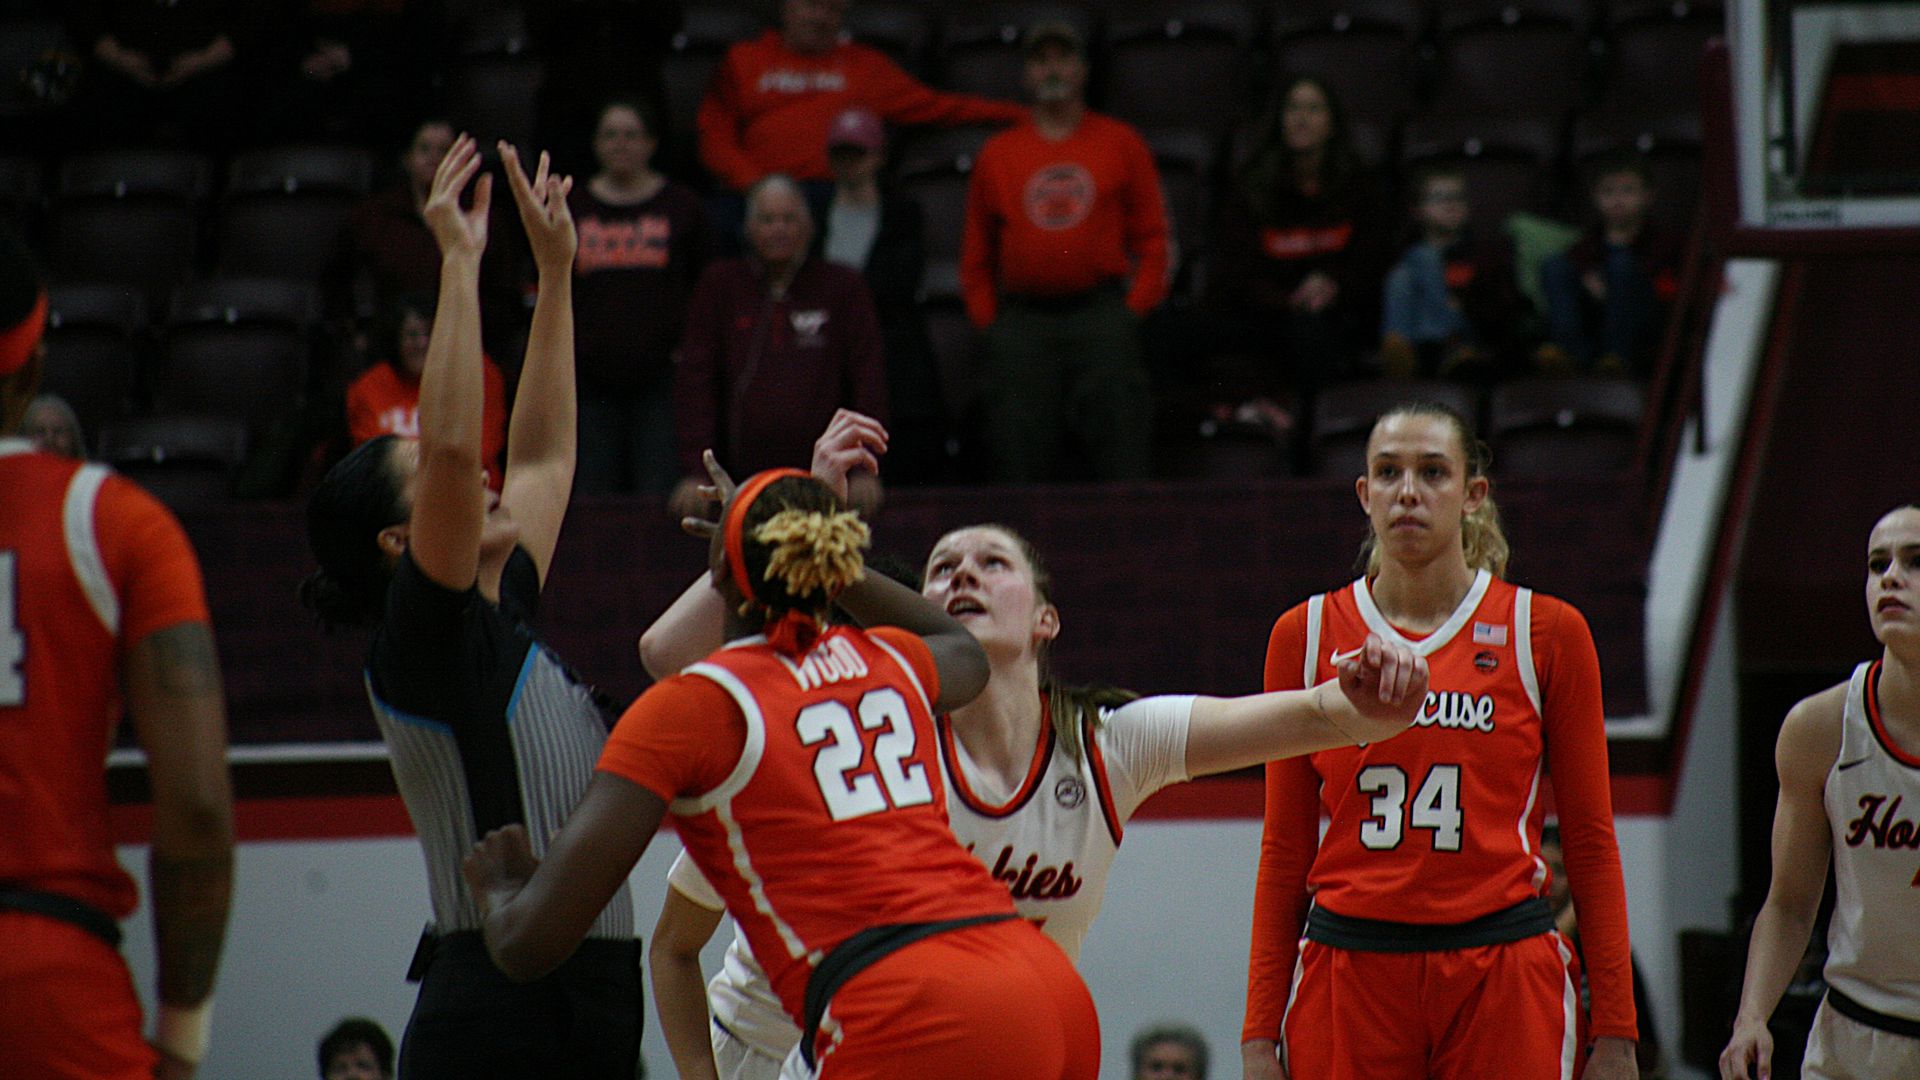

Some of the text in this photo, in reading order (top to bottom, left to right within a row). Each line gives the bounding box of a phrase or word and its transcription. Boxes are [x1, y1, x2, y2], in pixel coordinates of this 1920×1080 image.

[798, 635, 868, 692] WOOD
[794, 685, 934, 821] 22
[1357, 764, 1464, 852] 34
[1845, 794, 1920, 850] Ho
[966, 841, 1083, 900] kies
